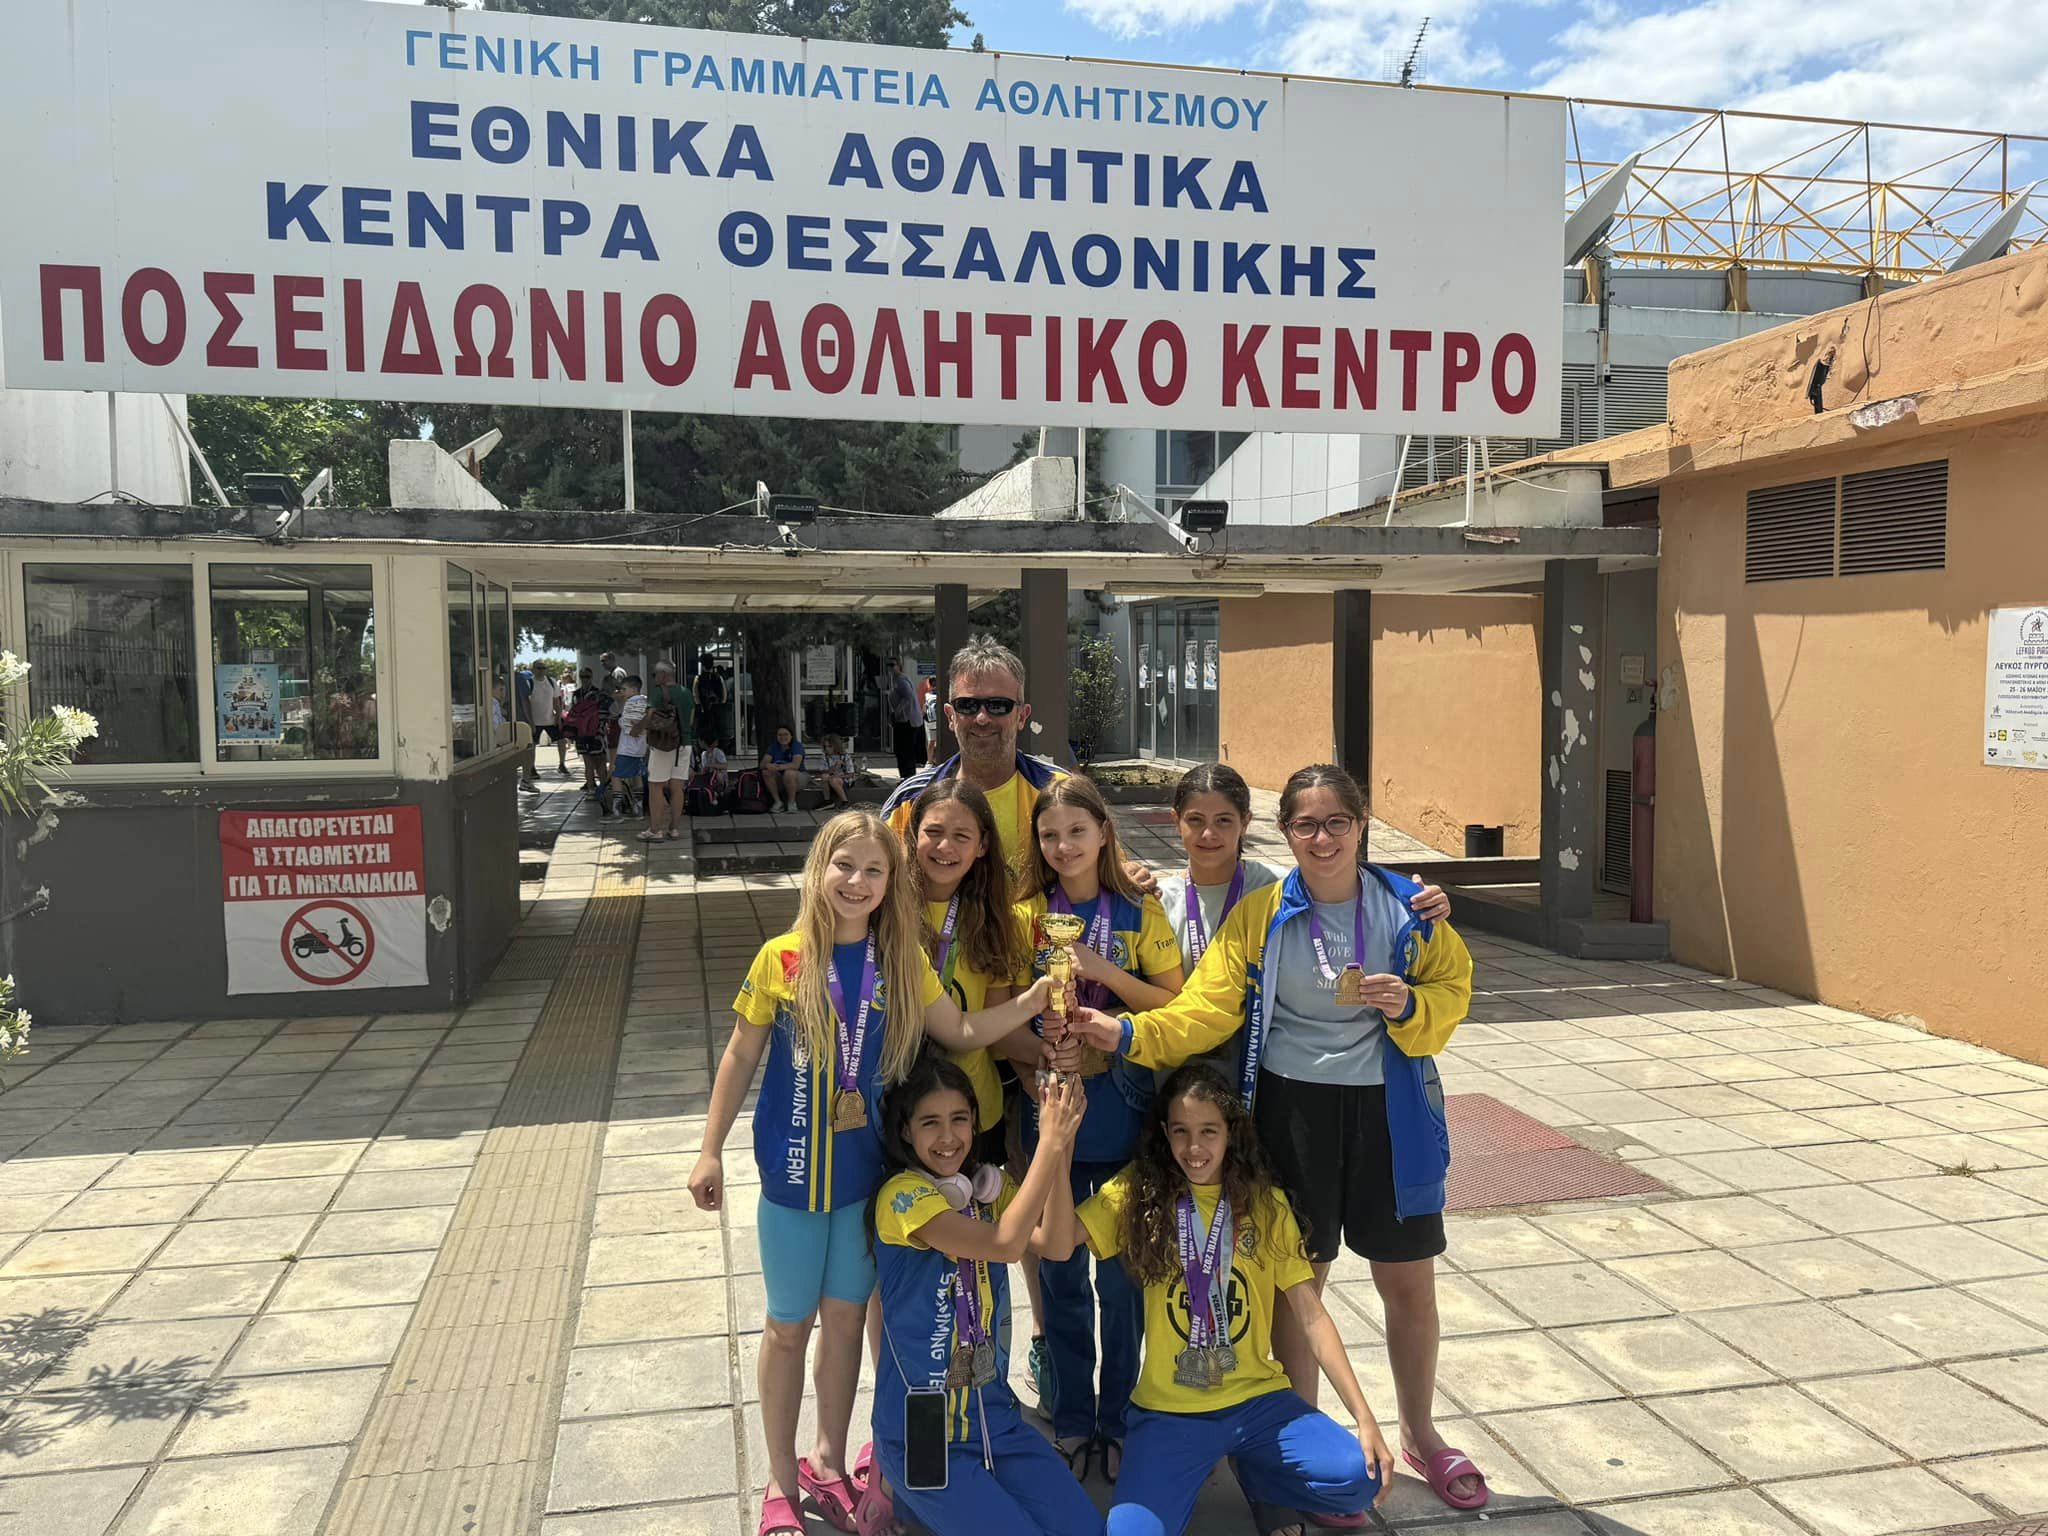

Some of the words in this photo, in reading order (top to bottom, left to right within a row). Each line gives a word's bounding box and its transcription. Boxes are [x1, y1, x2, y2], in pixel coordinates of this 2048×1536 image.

[405, 30, 600, 81] ΓΕΝΙΚΗ
[634, 49, 950, 110] ΓΡΑΜΜΑΤΕΙΑ
[975, 79, 1269, 132] ΑΘΛΗΤΙΣΜΟΥ
[410, 100, 775, 182] ΕΘΝΙΚΑ
[828, 132, 1269, 214] ΑΘΛΗΤΙΚΑ
[266, 181, 660, 262] ΚΕΝΤΡΑ
[718, 211, 1376, 299] ΘΕΣΣΑΛΟΝΙΚΗΣ
[39, 263, 697, 387] ΠΟΣΕΙΔΩΝΙΟ
[733, 300, 1188, 407] ΑΘΛΗΤΙΚΟ
[1221, 322, 1537, 416] ΚΕΝΤΡΟ
[1995, 662, 2022, 670] ΛΕΥΚΟΣ
[246, 814, 393, 838] ΑΠΑΓΟΡΕΥΕΤΑΙ
[253, 846, 268, 866] Η
[272, 843, 390, 866] ΣΤΑΘΜΕΥΣΗ
[228, 875, 261, 897] ΓΙΑ
[265, 874, 292, 895] ΤΑ
[296, 871, 418, 895] ΜΗΧΑΝΑΚΙΑ
[1322, 930, 1348, 943] With
[1328, 946, 1352, 958] OVE
[848, 1056, 860, 1076] 2024
[791, 1064, 808, 1128] MMING
[785, 1136, 807, 1185] TEAM
[1201, 1253, 1214, 1275] 2024
[928, 1367, 948, 1391] TE
